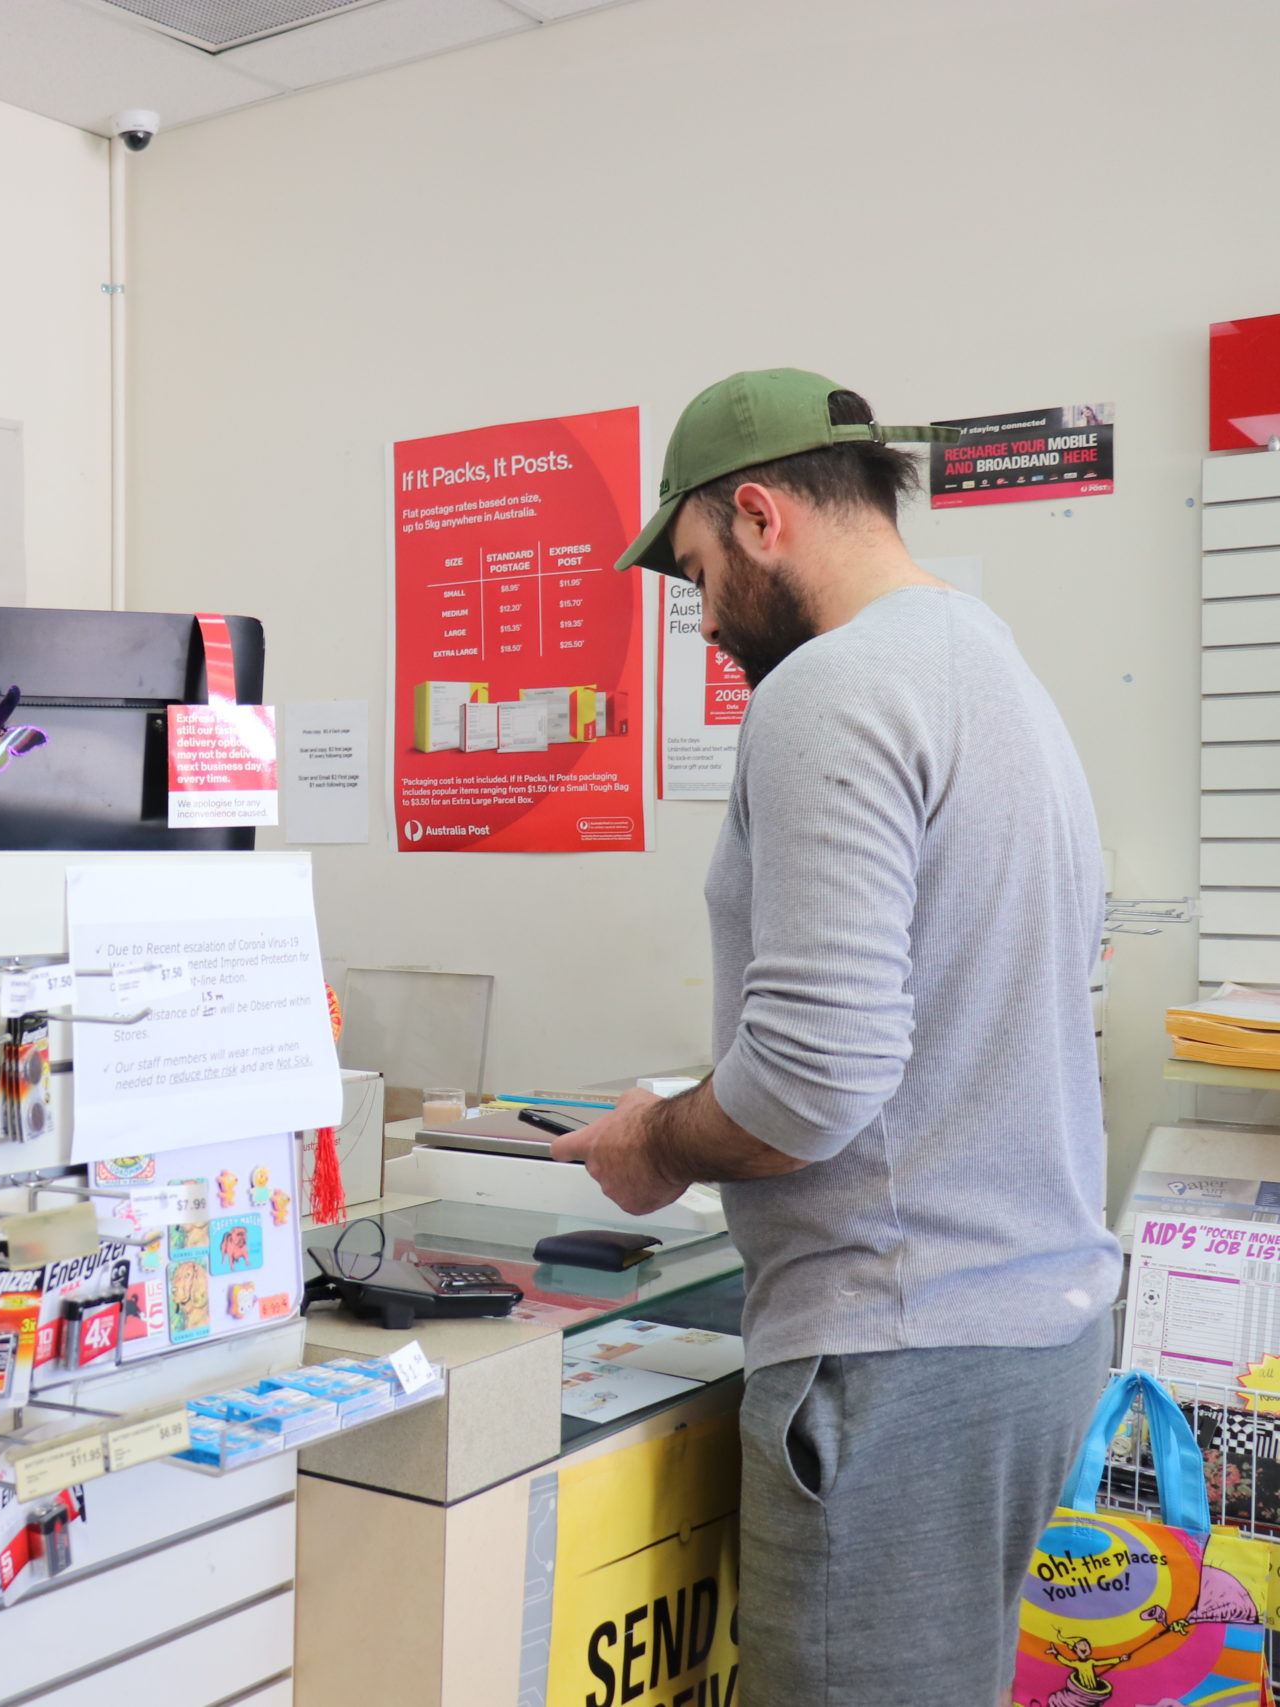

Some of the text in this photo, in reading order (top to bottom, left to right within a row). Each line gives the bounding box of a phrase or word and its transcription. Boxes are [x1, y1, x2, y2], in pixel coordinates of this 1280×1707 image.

[969, 418, 1046, 435] staying connected
[944, 433, 1098, 462] RECHARGE YOUR MOBILE
[402, 451, 573, 491] If It Packs, It Posts.
[945, 449, 1098, 476] AND BROADBAND HERE
[403, 496, 519, 520] Flat postage rates based on
[403, 508, 537, 533] up to 5kg anywhere in Australia.
[486, 544, 591, 562] STANDARD EXPRESS
[445, 556, 583, 573] SIZE POSTAGE POST
[443, 589, 466, 598] SMALL
[442, 609, 468, 618] MEDIUM
[444, 629, 466, 637] LARGE
[715, 689, 750, 701] 20GB
[176, 726, 212, 735] still our
[177, 738, 217, 748] delivery
[177, 750, 227, 761] may not be
[177, 762, 243, 771] next business
[177, 774, 231, 785] every time.
[579, 772, 617, 782] packaging
[402, 786, 507, 796] includes popular ranging
[177, 799, 232, 809] We apologise
[177, 810, 236, 818] inconvenience
[426, 824, 490, 835] Australia Post
[108, 937, 299, 956] Due to Recent escalation Corona Virus-19
[221, 953, 297, 969] Improved Protection
[47, 975, 72, 991] $7.50
[220, 973, 247, 984] Action.
[148, 996, 311, 1020] distance will be Observed within
[115, 1041, 299, 1074] Our staff members will wear mask when
[115, 1054, 313, 1091] needed to reduce the risk and are Not Sick.
[177, 1198, 207, 1211] $7.99
[1141, 1221, 1197, 1249] KID'S
[1204, 1239, 1242, 1256] JOB
[159, 1423, 182, 1440] $6.99
[71, 1448, 101, 1467] $11.95
[1037, 1550, 1168, 1582] Oh! the Places
[1043, 1572, 1131, 1602] You'll Go!
[586, 1576, 719, 1707] SEND
